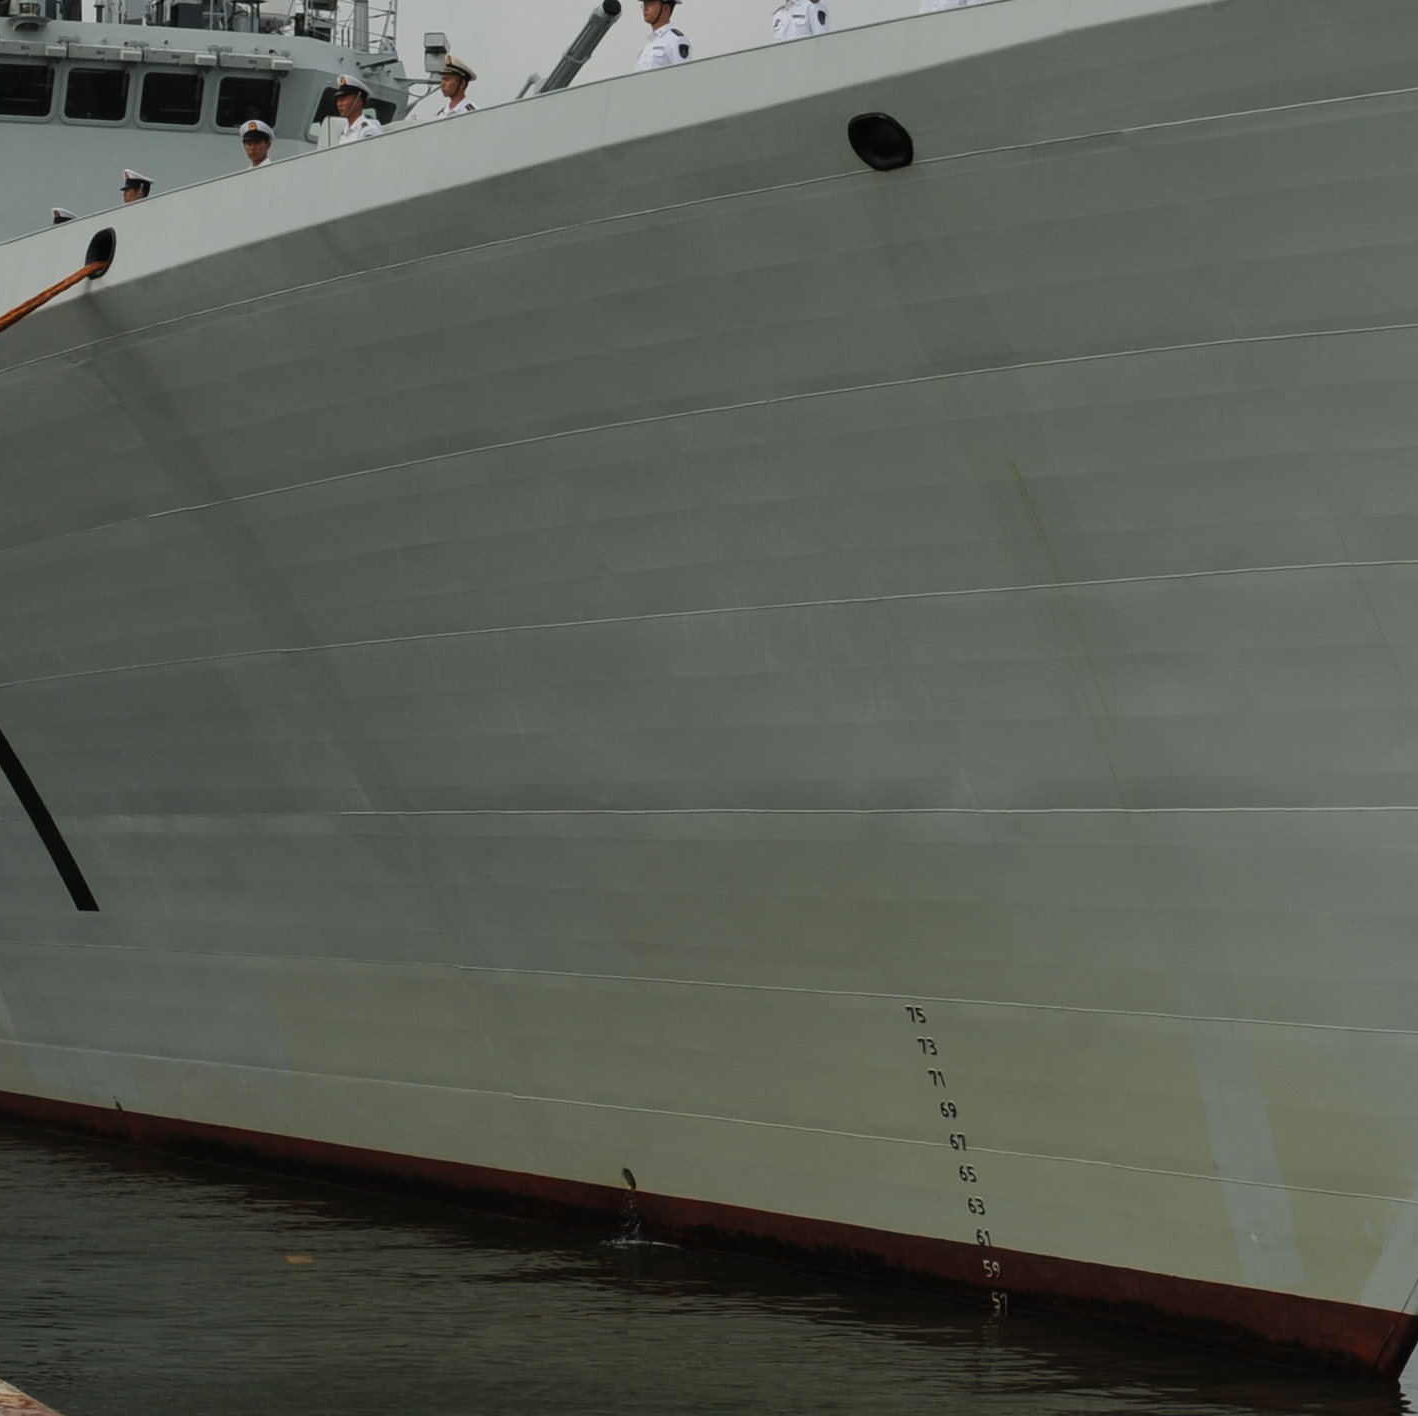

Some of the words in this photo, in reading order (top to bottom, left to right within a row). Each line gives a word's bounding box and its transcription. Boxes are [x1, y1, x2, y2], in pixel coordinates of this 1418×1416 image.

[905, 1005, 927, 1024] 75
[917, 1037, 938, 1056] 73
[928, 1069, 947, 1088] 71
[940, 1100, 958, 1119] 69
[950, 1132, 967, 1152] 67
[959, 1164, 977, 1183] 65
[968, 1196, 986, 1216] 63
[976, 1228, 992, 1247] 61
[983, 1259, 1000, 1279] 59
